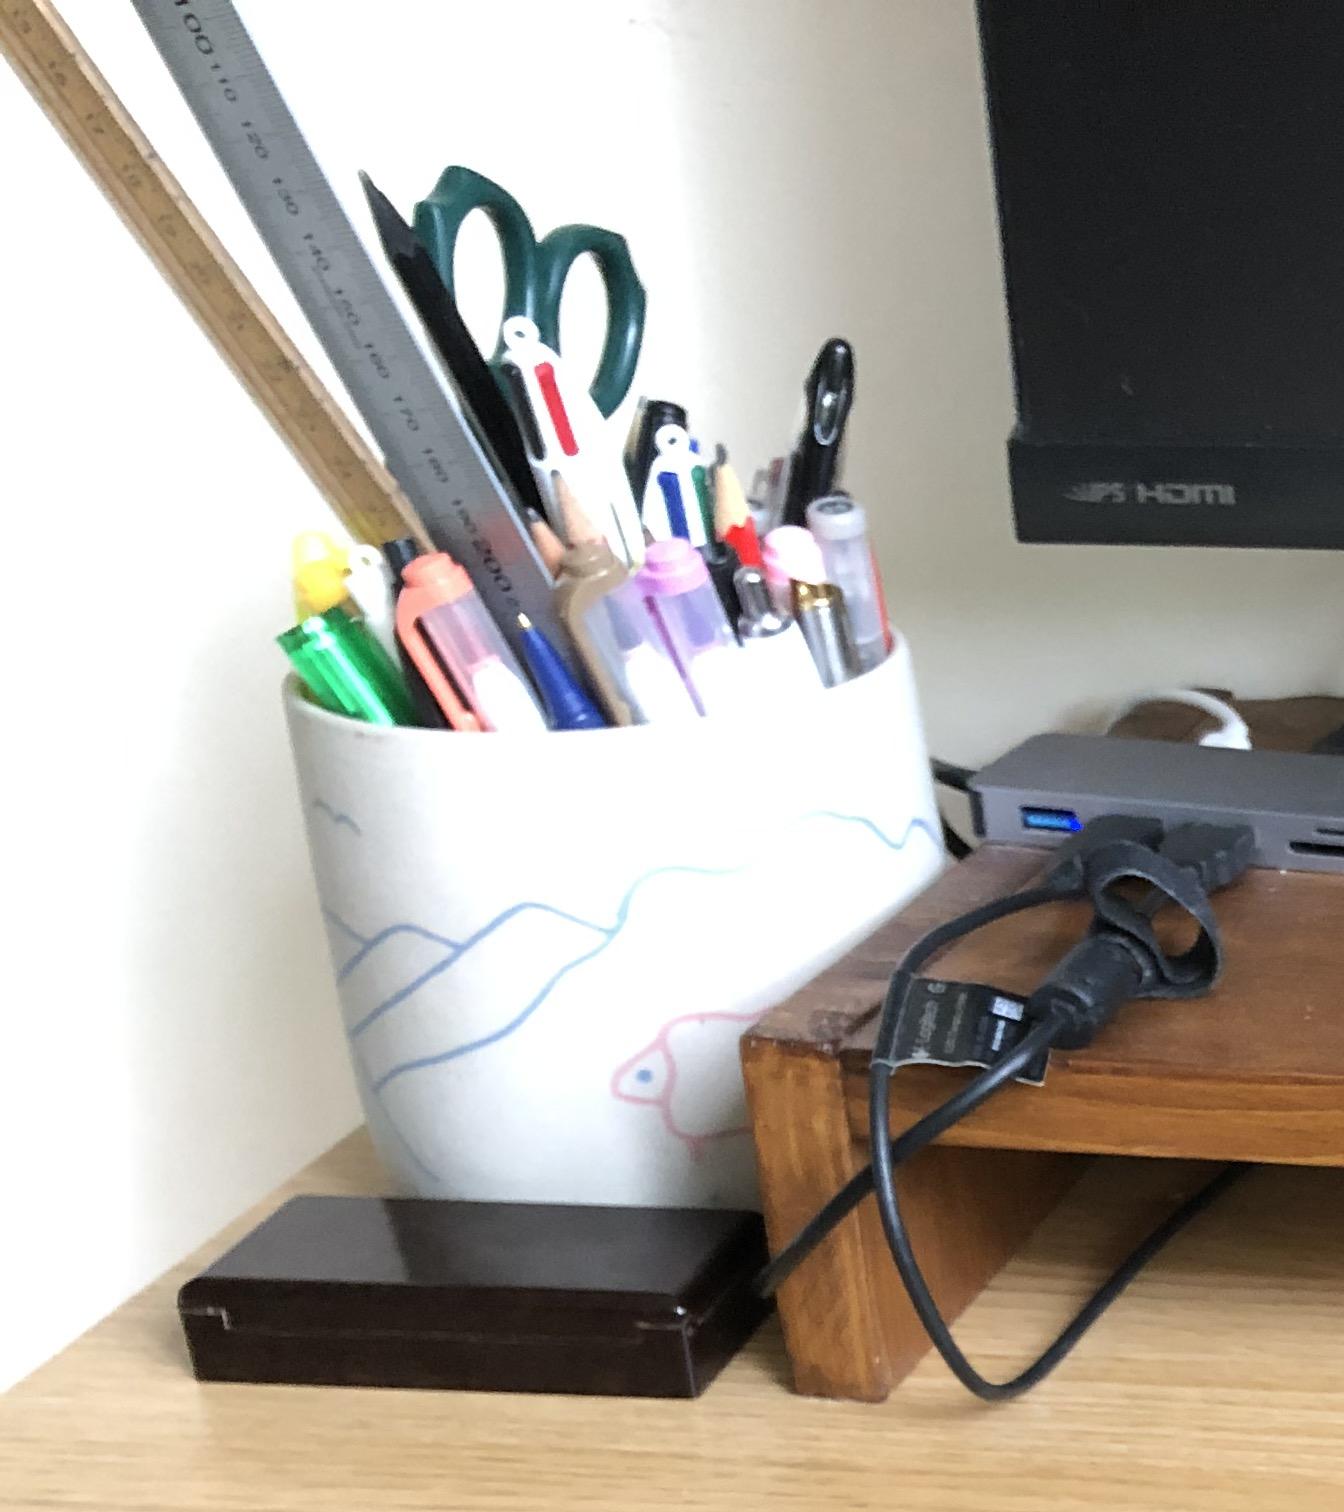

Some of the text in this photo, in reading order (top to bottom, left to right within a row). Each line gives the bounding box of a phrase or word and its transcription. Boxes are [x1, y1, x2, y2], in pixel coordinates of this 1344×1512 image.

[209, 62, 238, 104] 110
[241, 119, 269, 161] 120
[1136, 481, 1237, 506] HDMI
